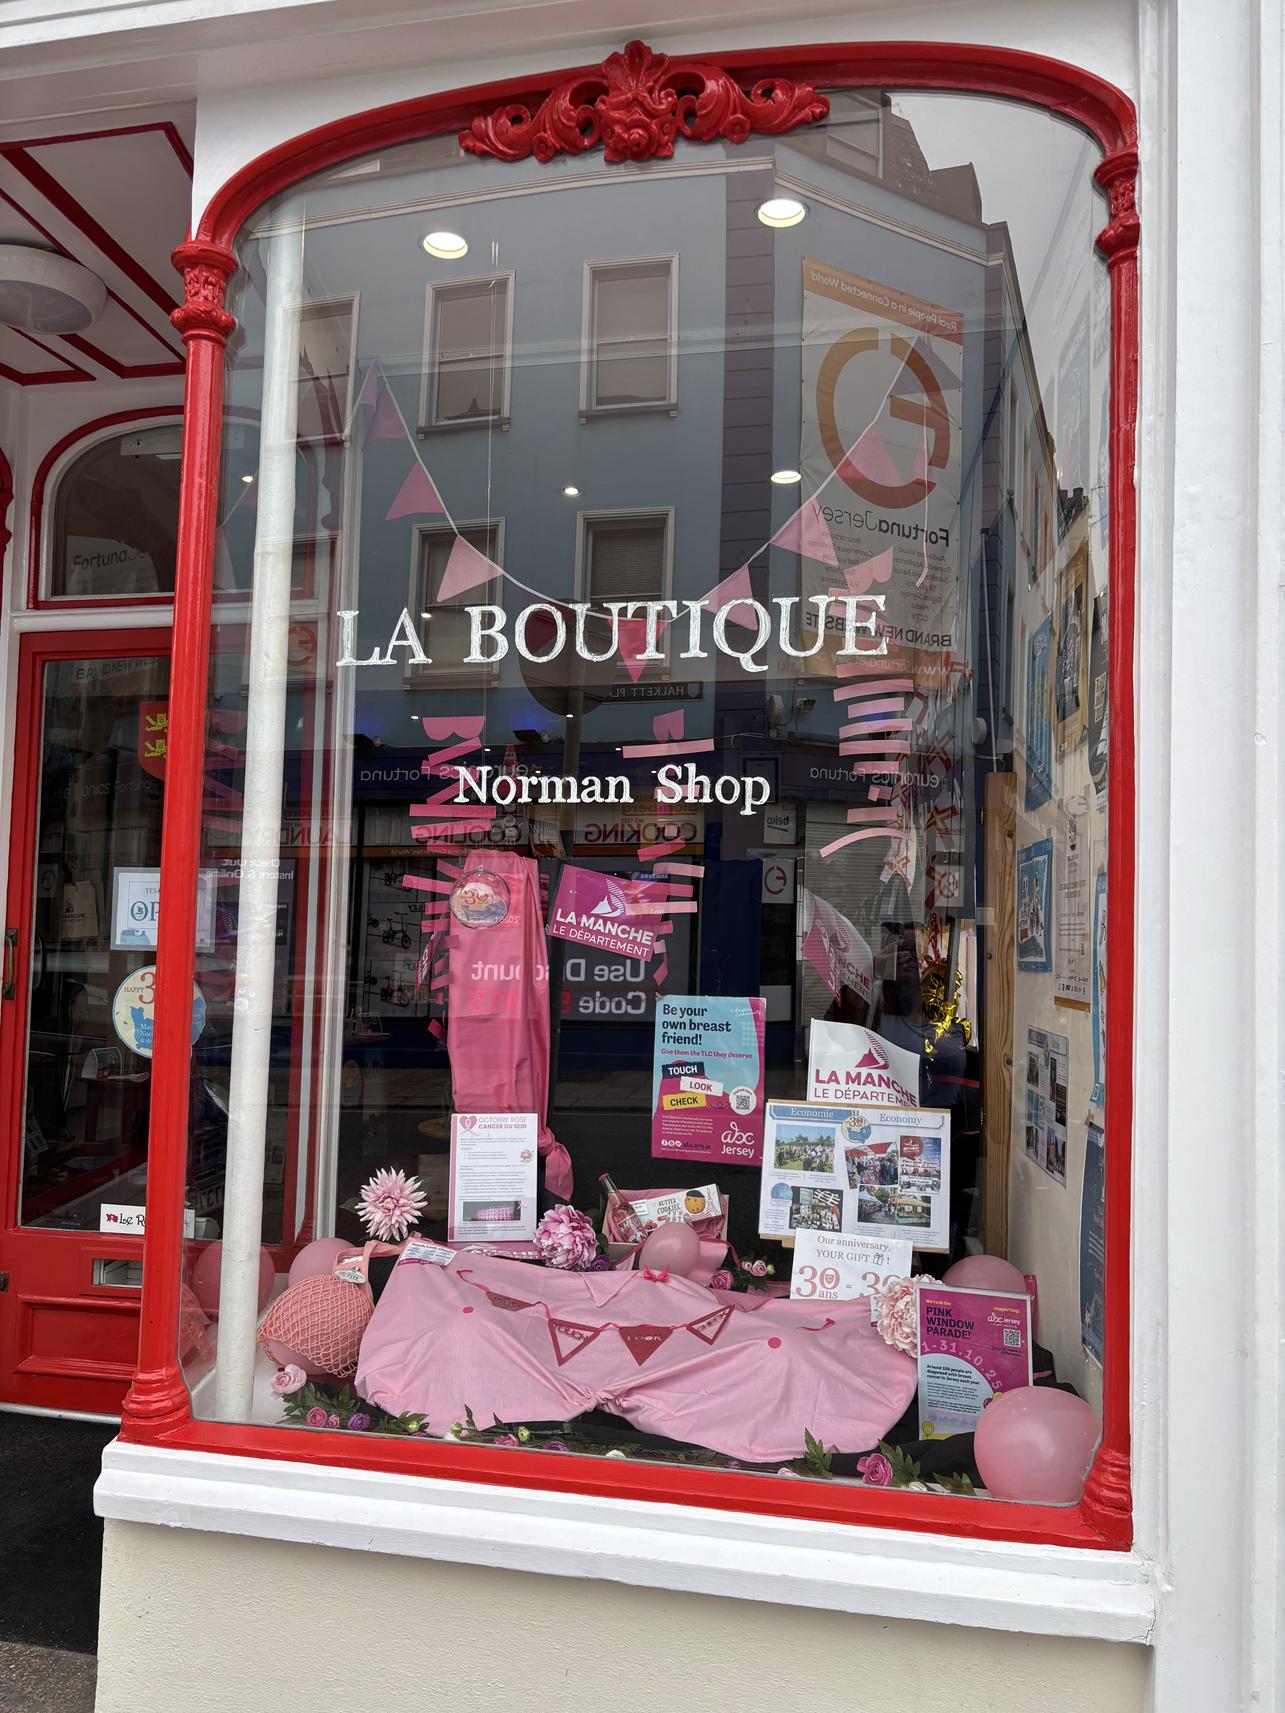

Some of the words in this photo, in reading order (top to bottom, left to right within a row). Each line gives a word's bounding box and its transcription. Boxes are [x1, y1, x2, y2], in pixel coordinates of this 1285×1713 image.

[336, 607, 433, 667] LA
[463, 594, 889, 673] BOUTIQUE
[64, 782, 111, 799] eonics
[453, 765, 634, 805] Norman
[656, 762, 771, 816] Shop
[131, 901, 160, 922] OP
[555, 908, 578, 926] LA
[580, 914, 655, 946] MANCHE
[552, 924, 567, 936] LE
[568, 928, 650, 958] DÉPARTEMENT
[138, 971, 156, 1005] 3
[663, 1004, 678, 1016] Be
[679, 1006, 708, 1019] your
[662, 1021, 687, 1031] own
[688, 1019, 732, 1033] breast
[661, 1031, 703, 1046] friend!
[713, 1051, 727, 1059] they
[668, 1065, 698, 1076] TOUCH
[689, 1081, 713, 1092] LOOK
[814, 1087, 830, 1098] LE
[815, 1068, 841, 1085] LA
[845, 1070, 917, 1107] MANCHE
[670, 1096, 699, 1107] CHECK
[790, 1108, 834, 1119] Economie
[879, 1113, 923, 1126] Economy
[721, 1121, 755, 1145] abc
[721, 1145, 755, 1159] Jersey
[656, 1203, 681, 1215] COOKIES
[658, 1197, 677, 1207] BUTTER
[118, 1212, 134, 1226] Le
[817, 1235, 835, 1245] Our
[836, 1238, 892, 1253] anniversary,
[816, 1249, 844, 1261] YOUR
[846, 1252, 870, 1263] GIFT
[796, 1265, 841, 1297] 30
[818, 1289, 838, 1299] ans
[926, 1306, 952, 1317] PINK
[926, 1317, 975, 1330] WINDOW
[553, 1323, 592, 1342] TOUCH
[926, 1326, 971, 1340] PARADE!
